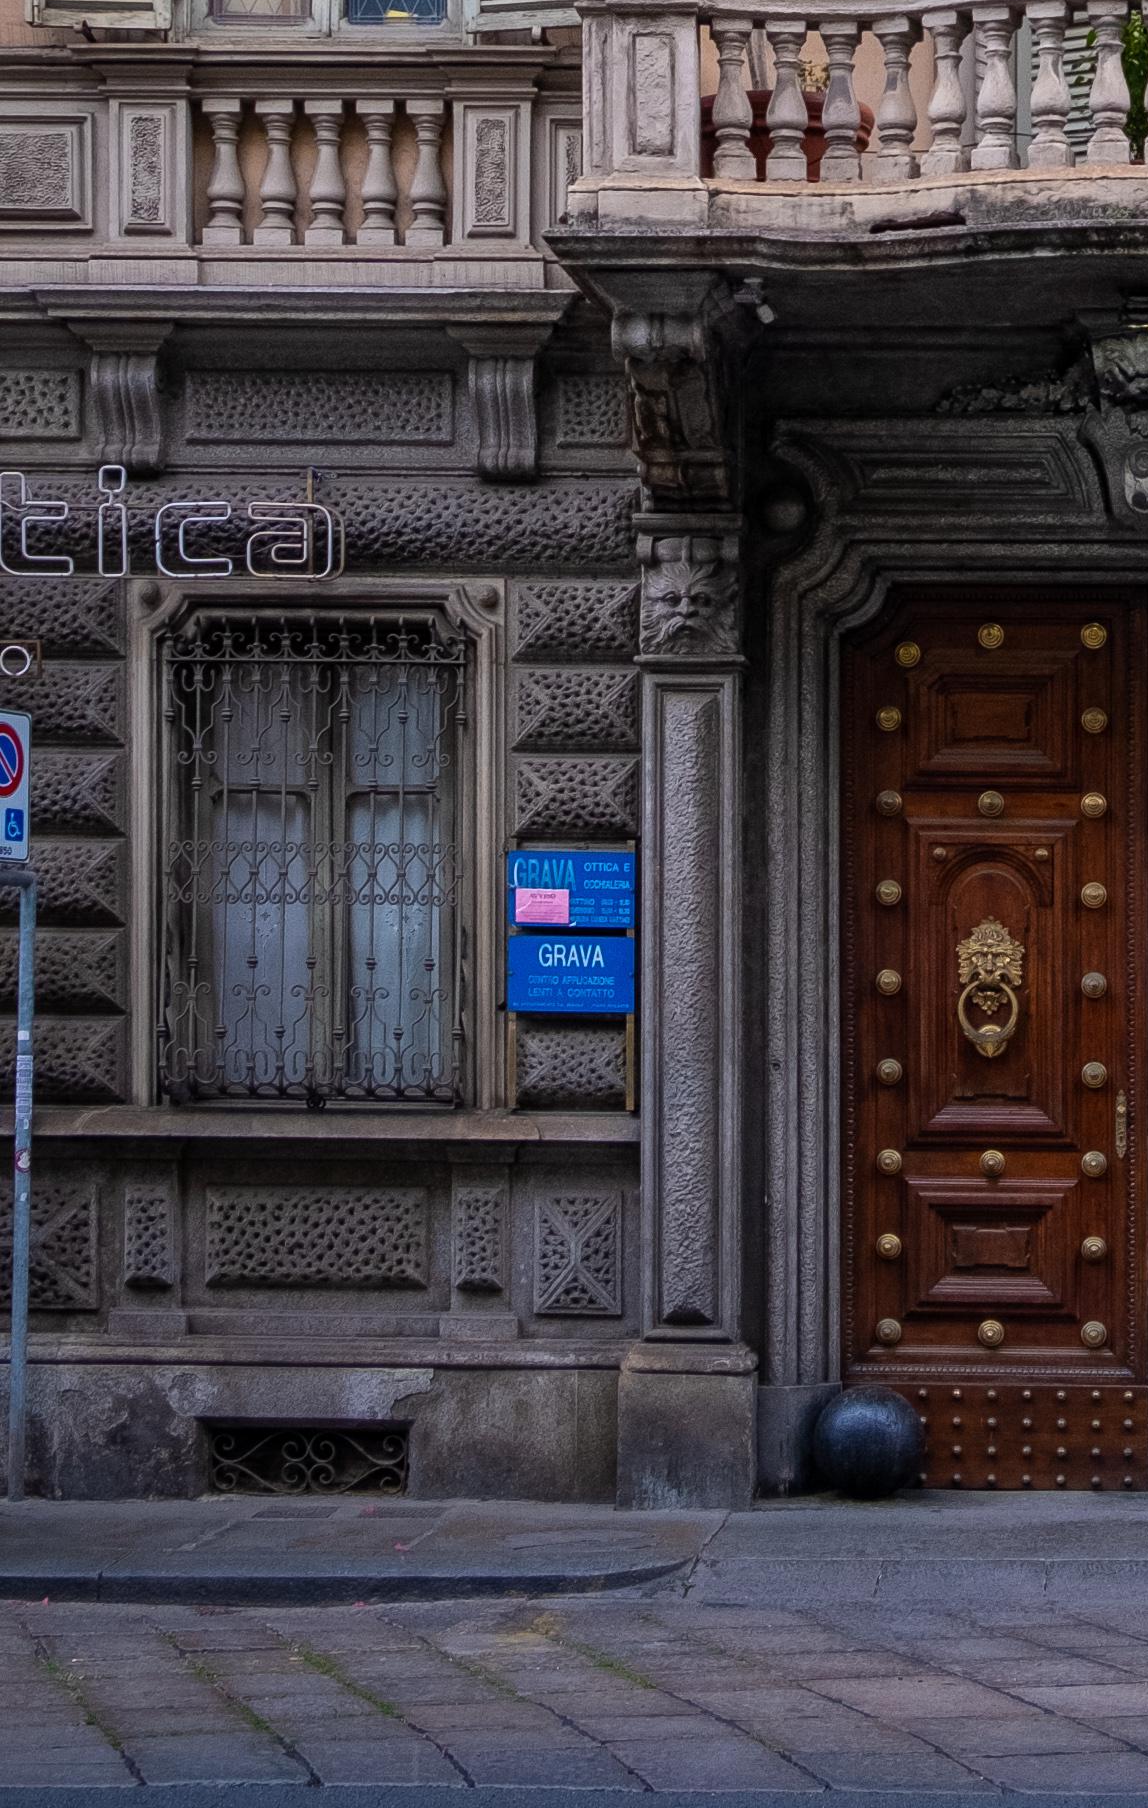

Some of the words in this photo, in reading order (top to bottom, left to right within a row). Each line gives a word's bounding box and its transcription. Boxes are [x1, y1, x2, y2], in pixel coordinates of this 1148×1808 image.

[583, 862, 619, 872] OTTICA
[624, 863, 631, 872] E
[514, 858, 577, 891] GRAVA
[583, 879, 630, 889] OCCHIALERIA
[538, 943, 605, 968] GRAVA
[562, 976, 615, 985] APPLICAZIONE
[528, 987, 553, 997] LENTI
[567, 988, 615, 998] CONTATTO
